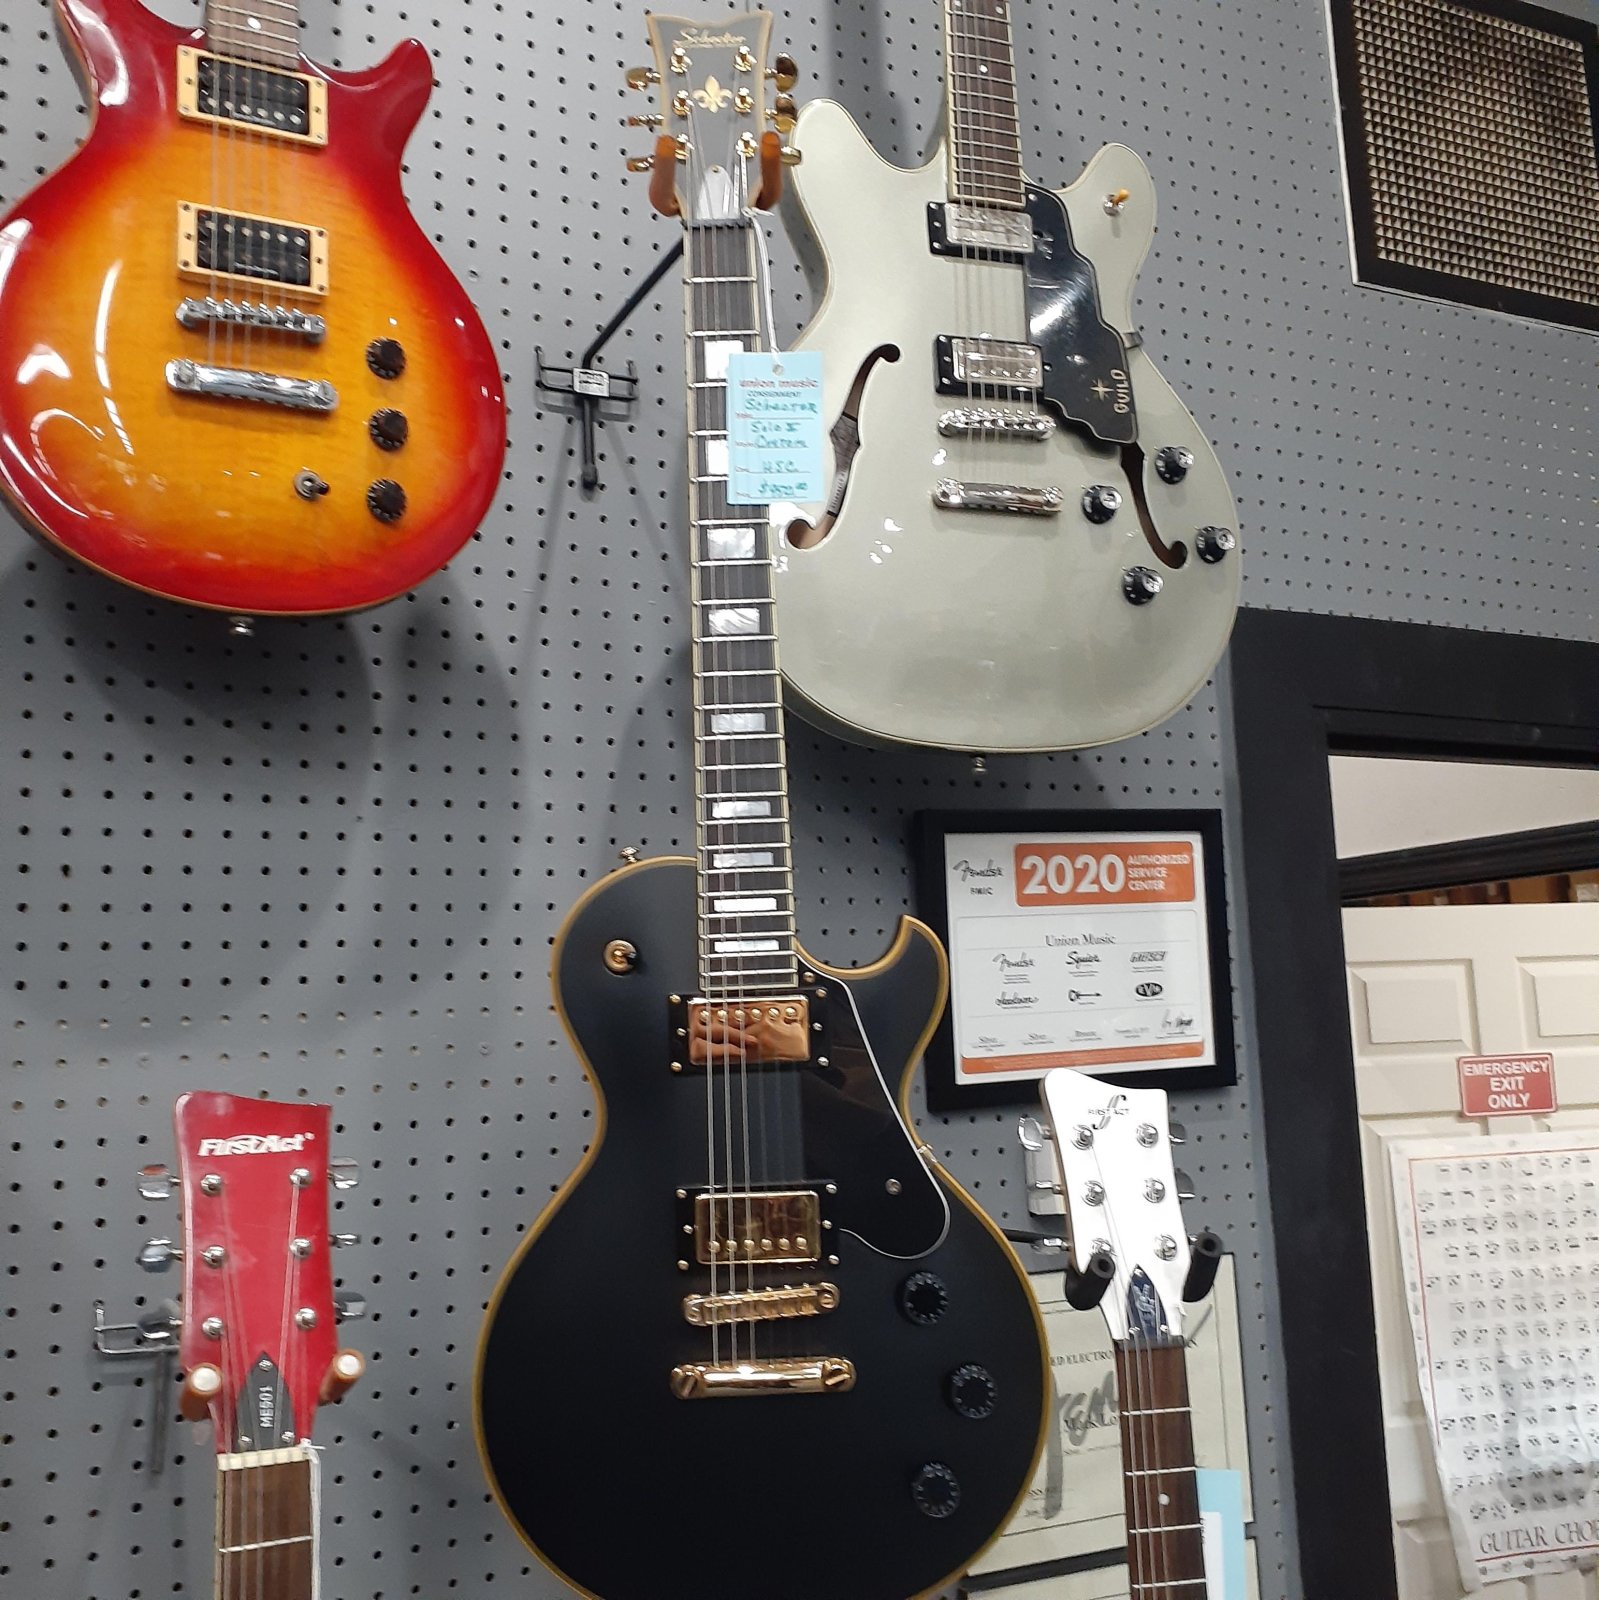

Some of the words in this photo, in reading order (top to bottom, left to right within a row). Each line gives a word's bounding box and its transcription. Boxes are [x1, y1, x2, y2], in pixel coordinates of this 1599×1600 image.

[1110, 369, 1130, 414] GUILD
[1021, 854, 1126, 895] 2020
[1127, 854, 1191, 866] AUTHORIZED
[1127, 867, 1168, 878] SERVICE
[1127, 880, 1166, 891] CENTER
[1045, 933, 1080, 947] Union
[1081, 932, 1117, 945] Music
[1463, 1060, 1549, 1076] EMERGENCY
[1490, 1076, 1525, 1092] EXIT
[1487, 1092, 1531, 1109] ONLY
[258, 1386, 274, 1428] ME501
[1479, 1525, 1549, 1554] GUITAR
[1554, 1518, 1599, 1544] CHO
